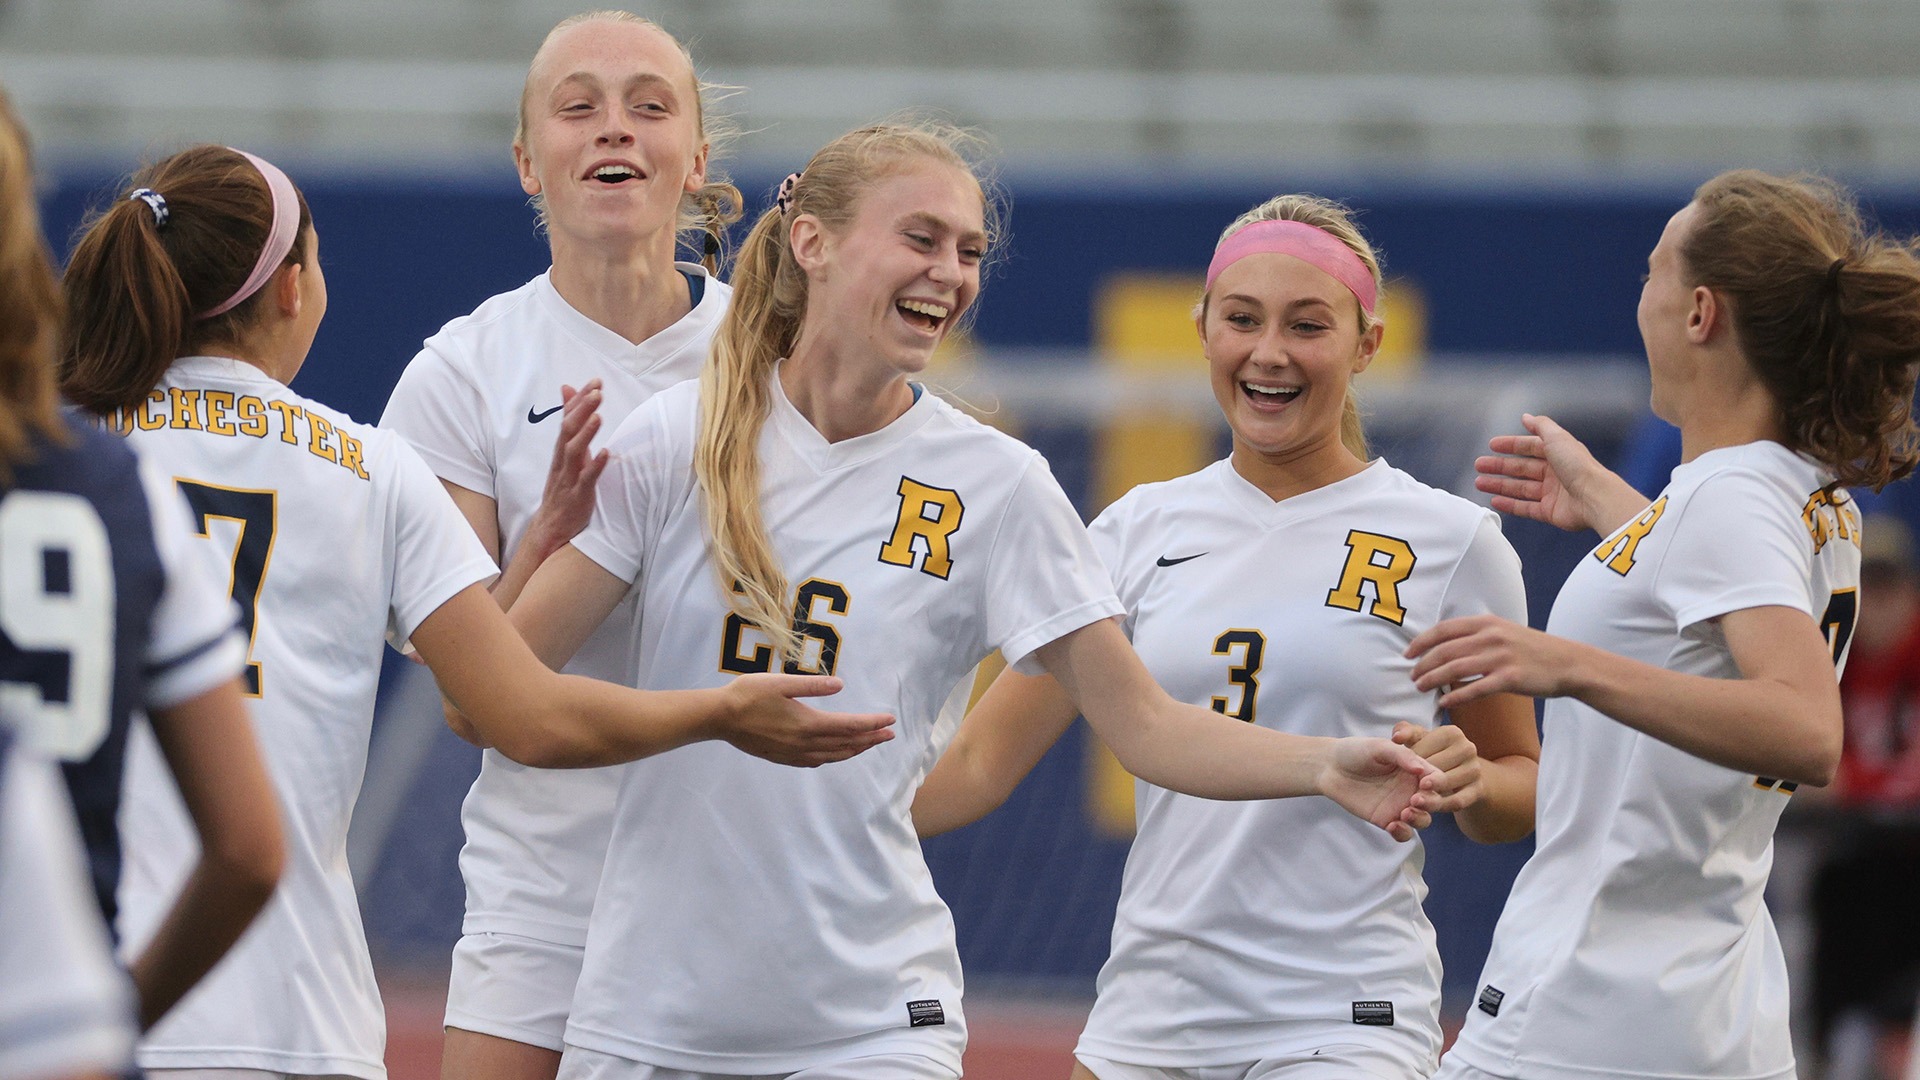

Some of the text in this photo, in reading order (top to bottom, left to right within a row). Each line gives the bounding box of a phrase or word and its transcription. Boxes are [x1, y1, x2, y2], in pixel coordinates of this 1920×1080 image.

[92, 386, 370, 481] OCHESTER
[878, 475, 965, 581] R
[1593, 494, 1668, 577] R
[0, 487, 116, 764] 9
[172, 476, 278, 699] 7
[1325, 529, 1418, 627] R
[1211, 628, 1267, 723] 3
